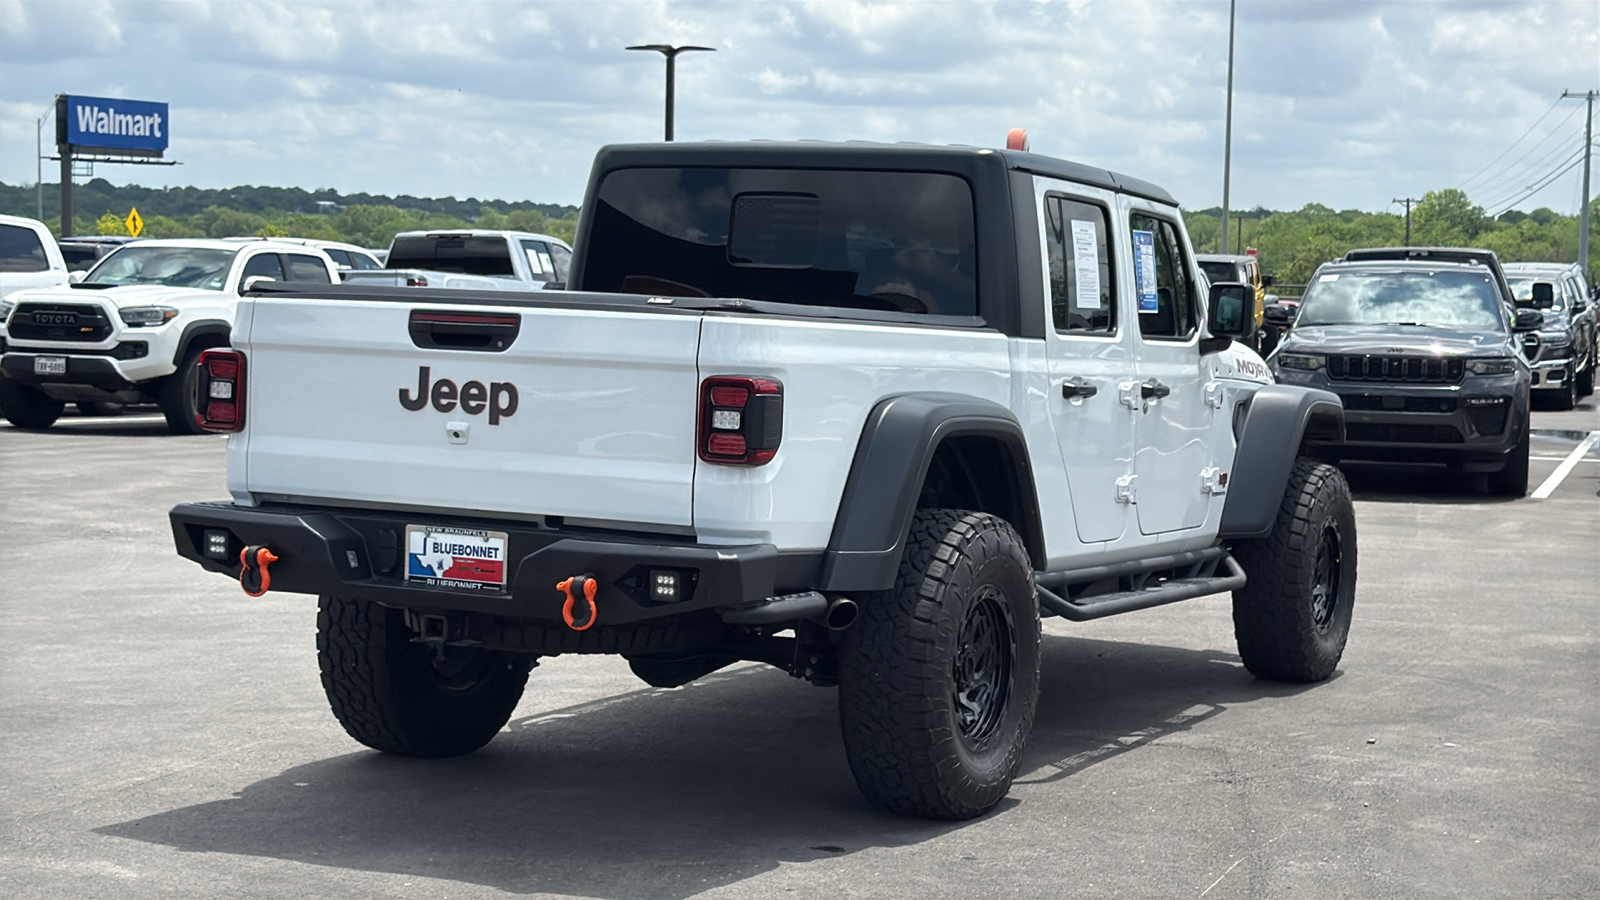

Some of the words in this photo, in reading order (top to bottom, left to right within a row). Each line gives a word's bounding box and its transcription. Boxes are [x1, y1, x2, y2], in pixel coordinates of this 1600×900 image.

[77, 105, 162, 138] Walmart
[35, 314, 75, 324] TOYOTA
[398, 365, 519, 426] Jeep
[445, 527, 488, 537] BRAUNFELS
[432, 542, 499, 559] BLUEBONNET
